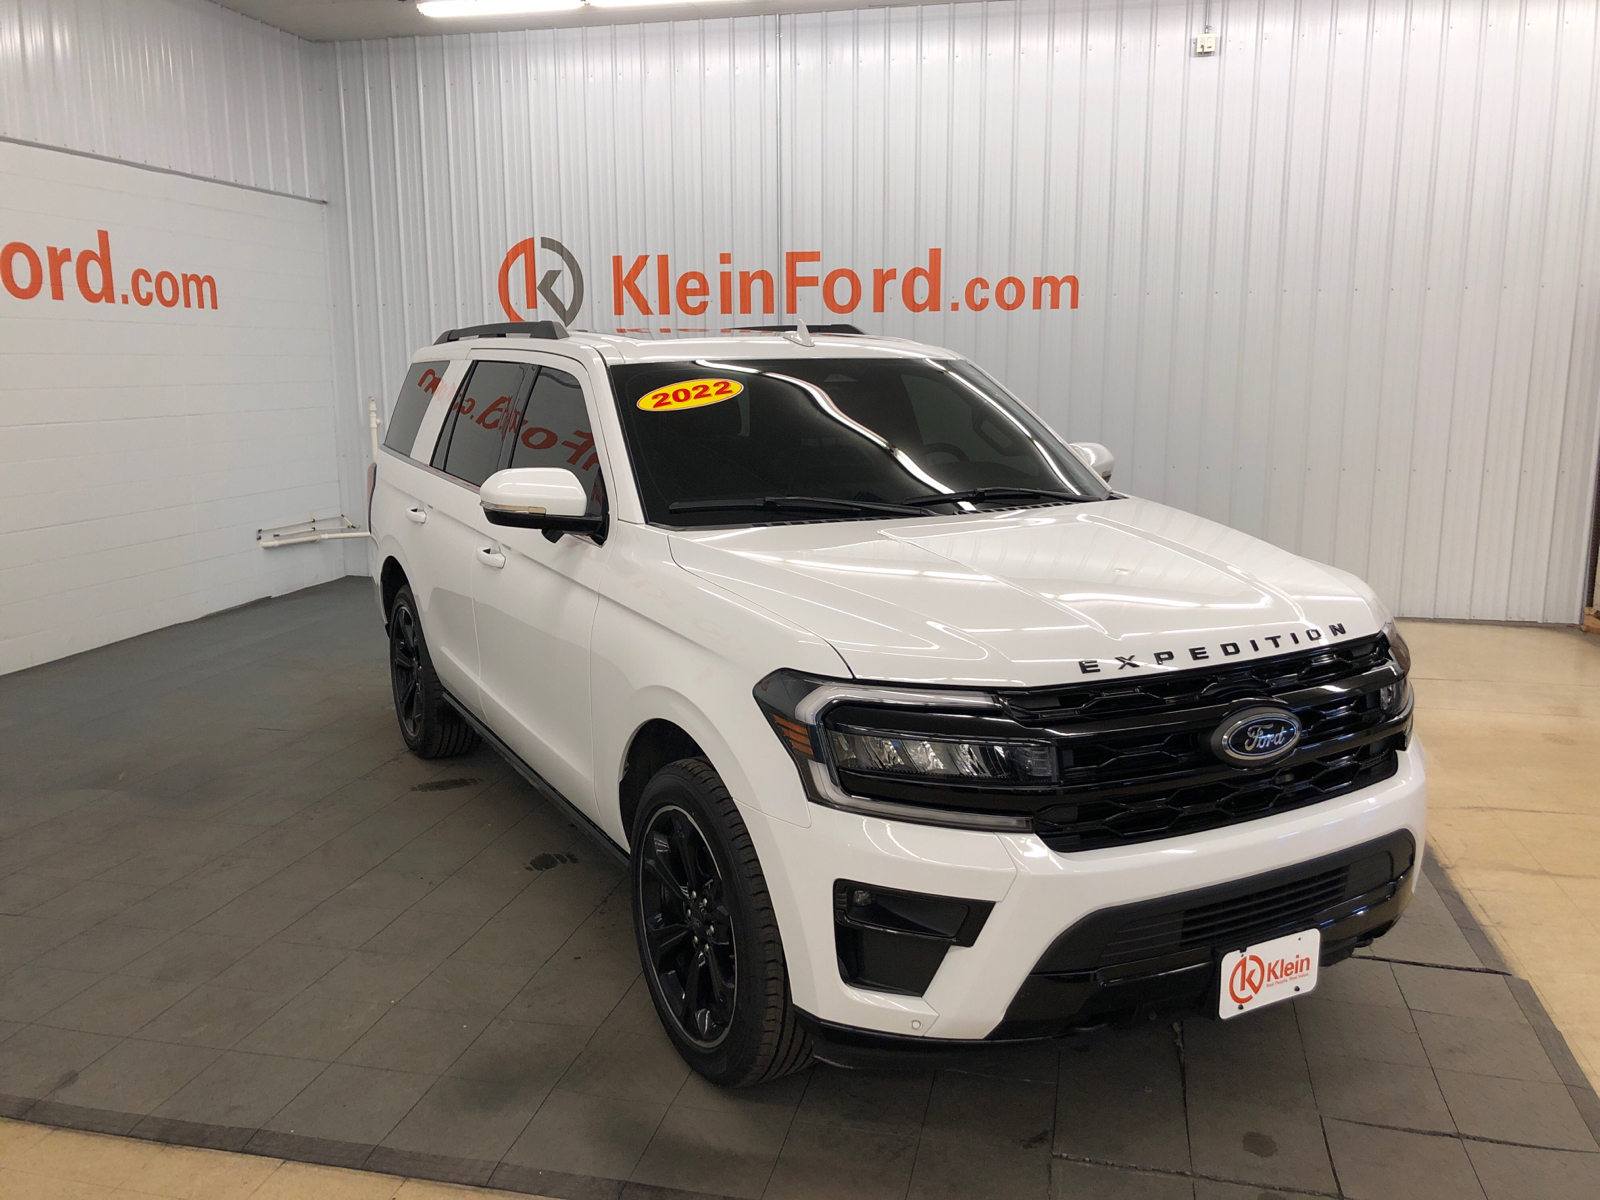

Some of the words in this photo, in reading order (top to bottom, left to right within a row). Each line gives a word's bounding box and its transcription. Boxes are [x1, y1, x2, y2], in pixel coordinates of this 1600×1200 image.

[612, 247, 1080, 316] KleinFord.com
[651, 380, 733, 409] 2022
[1079, 622, 1346, 674] EXPEDITION
[1244, 722, 1286, 751] Ford
[1267, 954, 1310, 983] Klein
